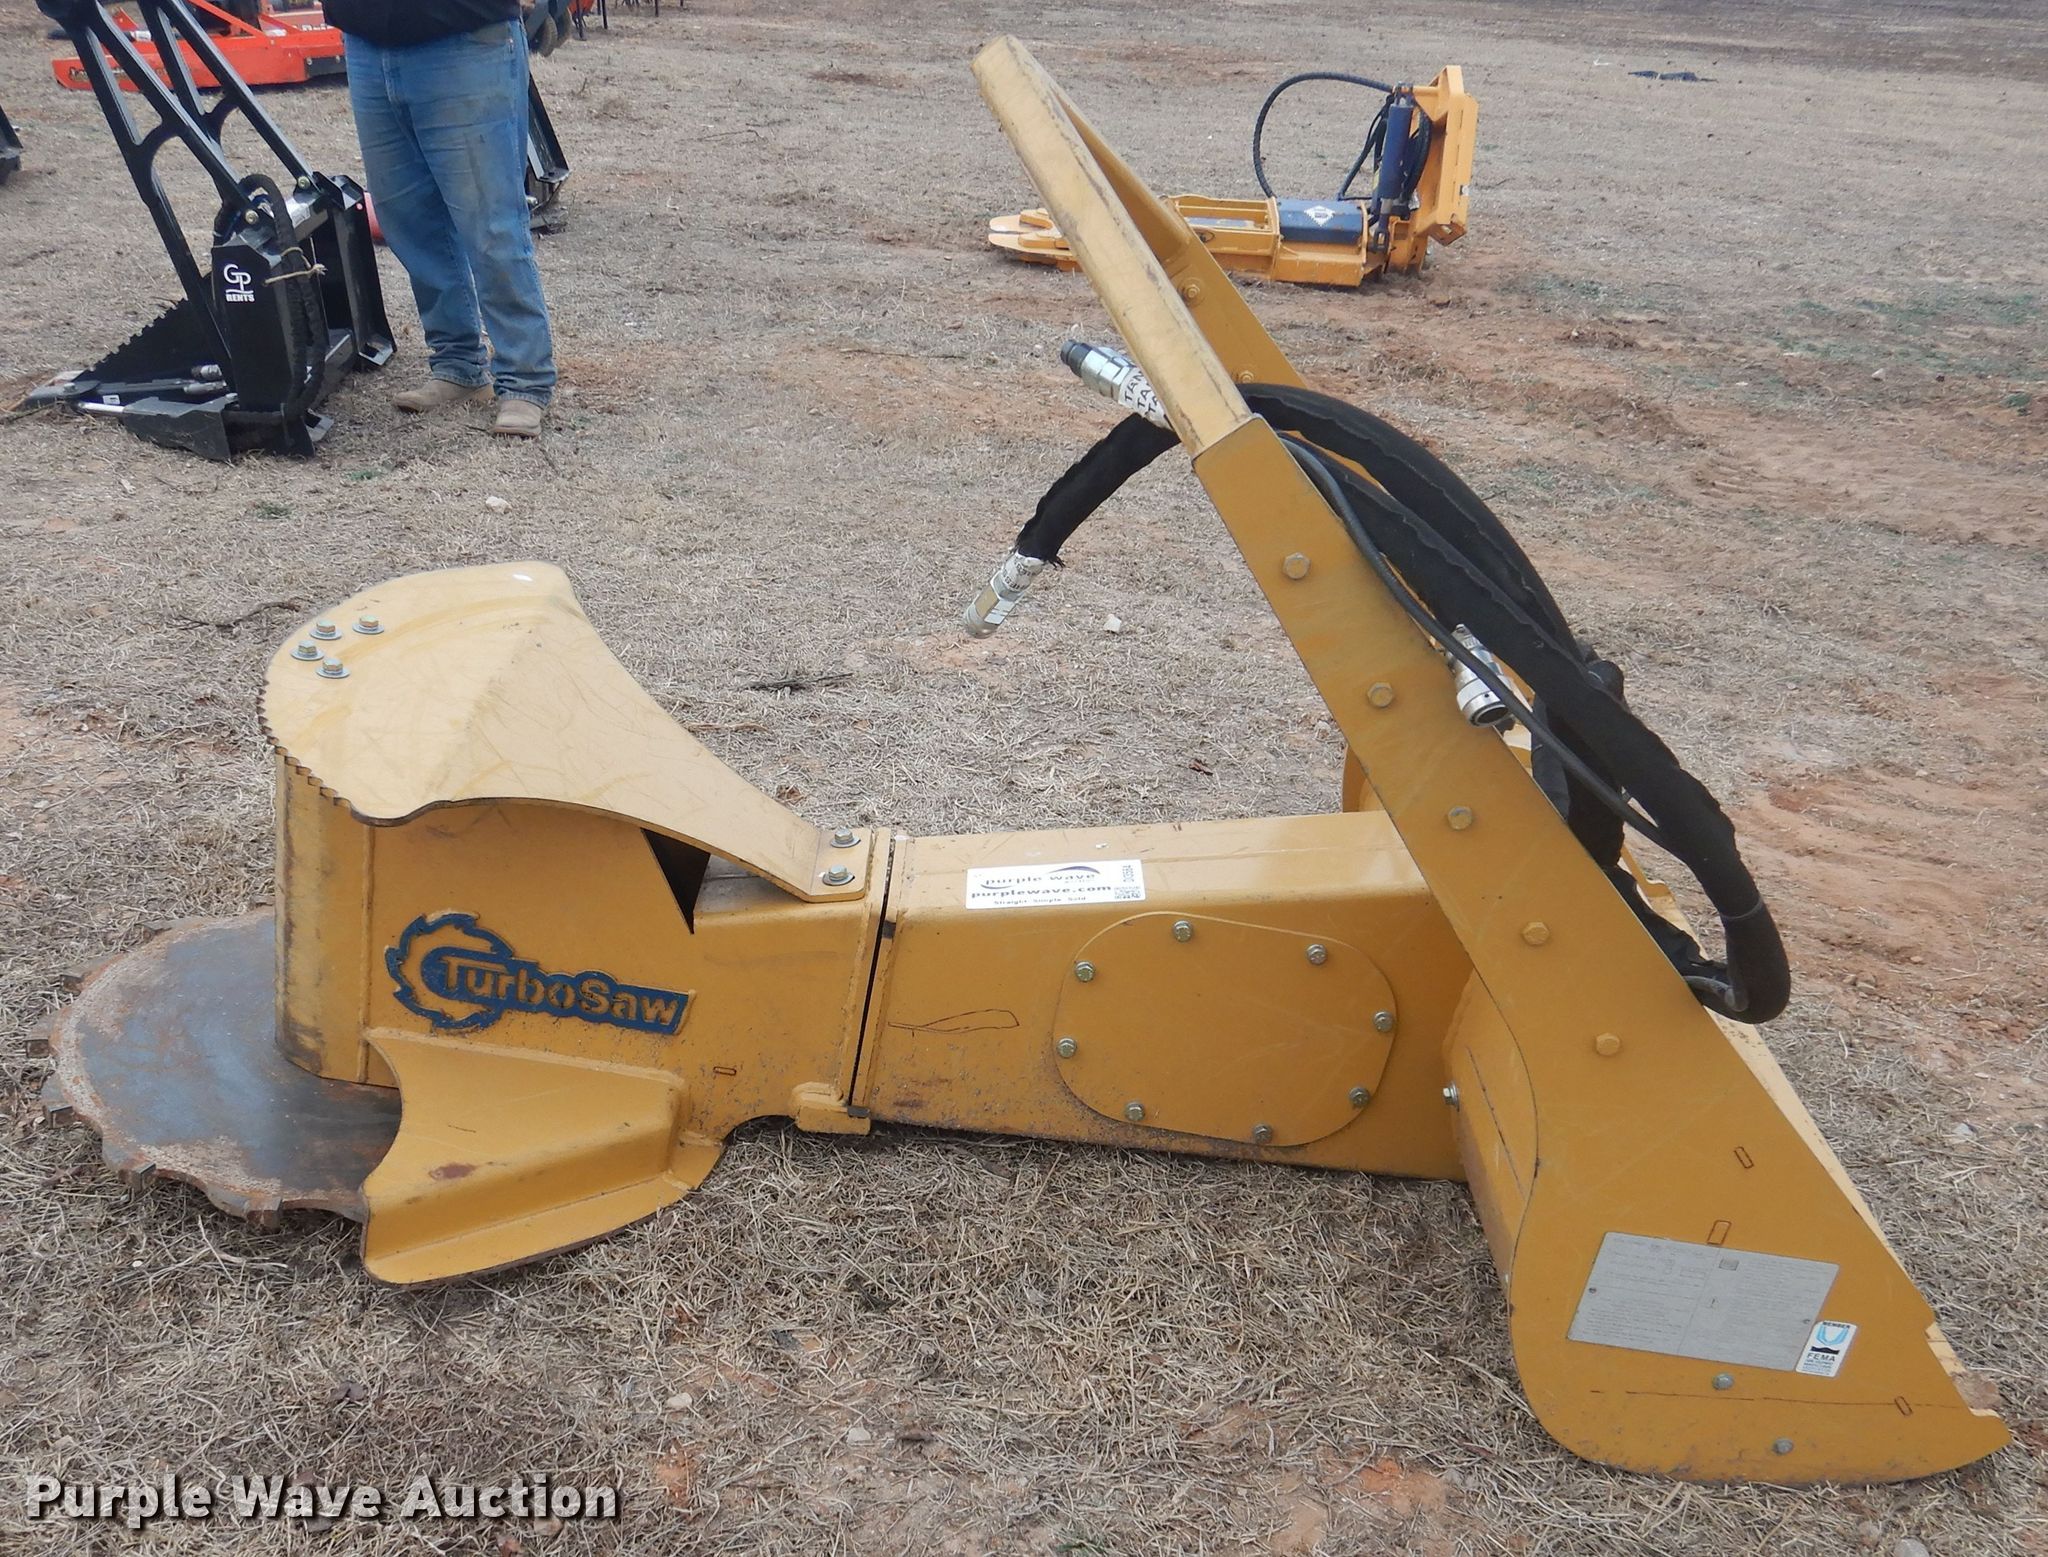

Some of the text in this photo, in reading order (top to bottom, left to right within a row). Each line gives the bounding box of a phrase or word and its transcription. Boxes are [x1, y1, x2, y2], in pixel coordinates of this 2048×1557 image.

[985, 873, 1096, 885] purple wave
[971, 885, 1112, 899] purplewave.com
[440, 955, 681, 1026] TurboSaw
[1807, 1353, 1836, 1362] FEMA
